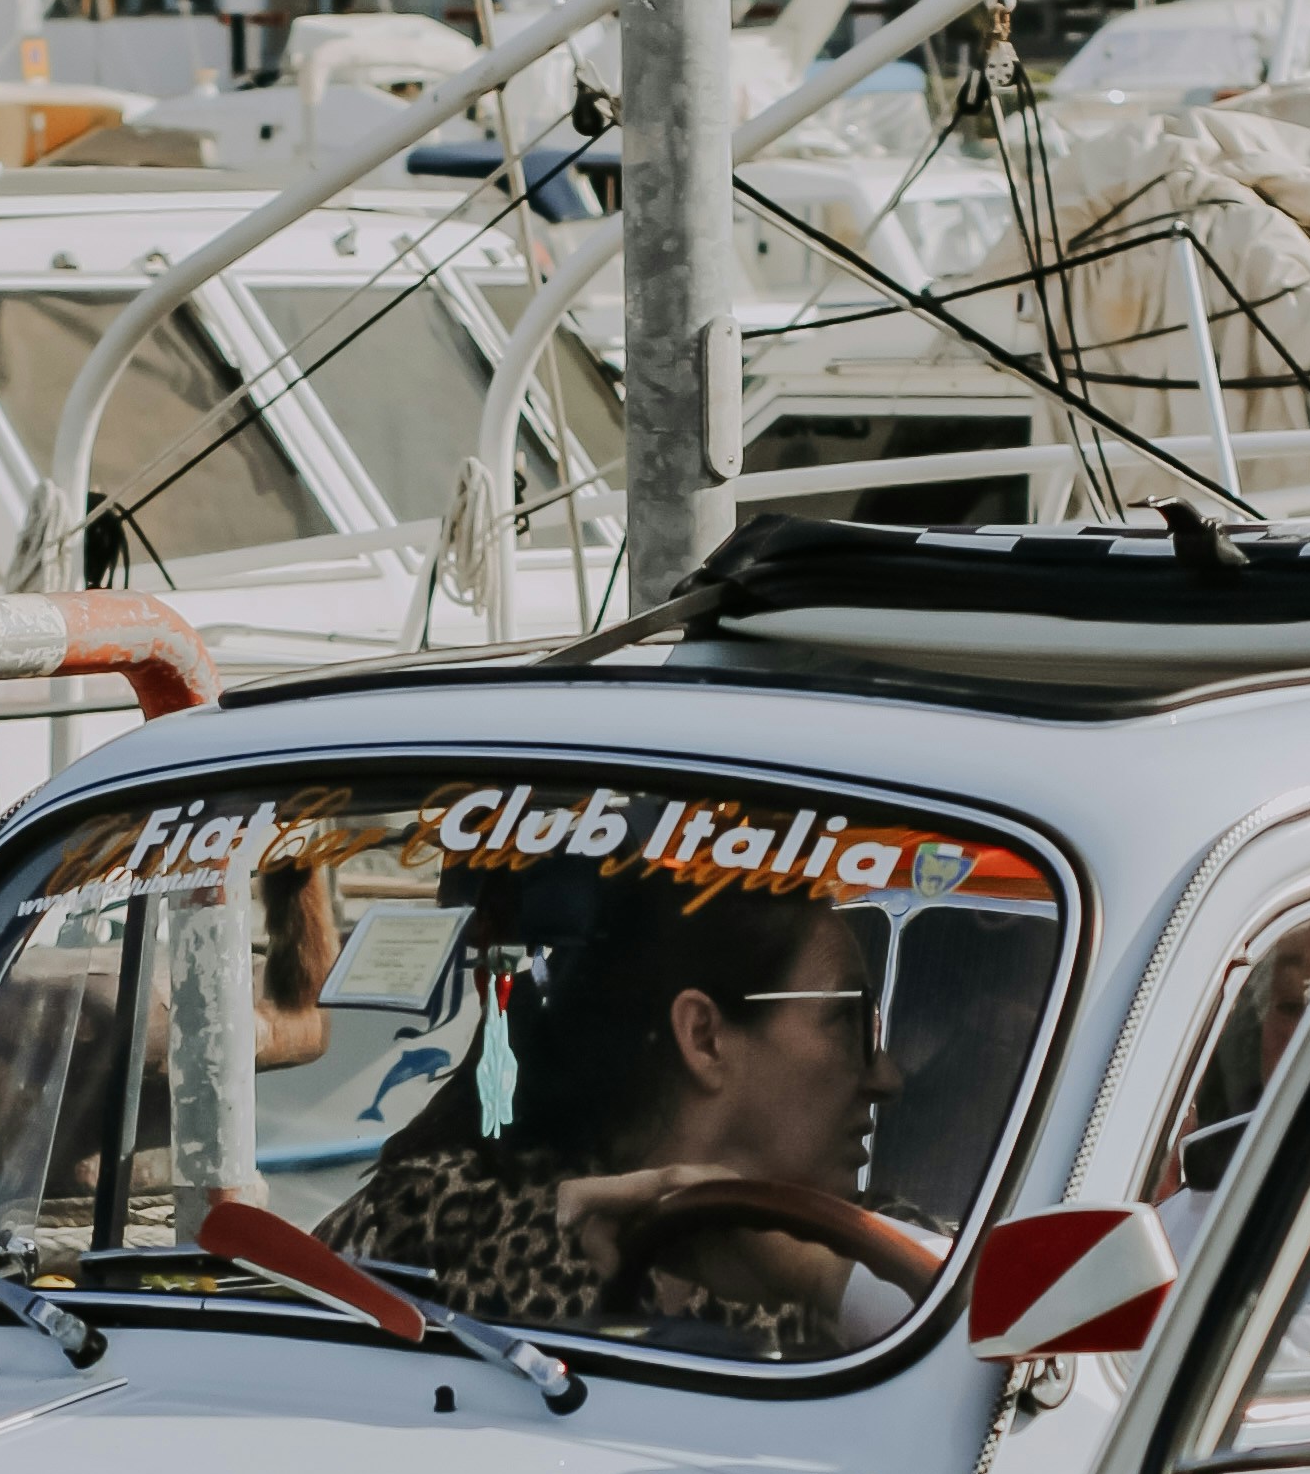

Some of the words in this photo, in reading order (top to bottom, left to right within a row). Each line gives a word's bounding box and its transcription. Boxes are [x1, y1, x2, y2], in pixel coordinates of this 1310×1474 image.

[125, 800, 277, 869] Fiat
[440, 786, 627, 856] Club
[643, 801, 902, 889] Italia
